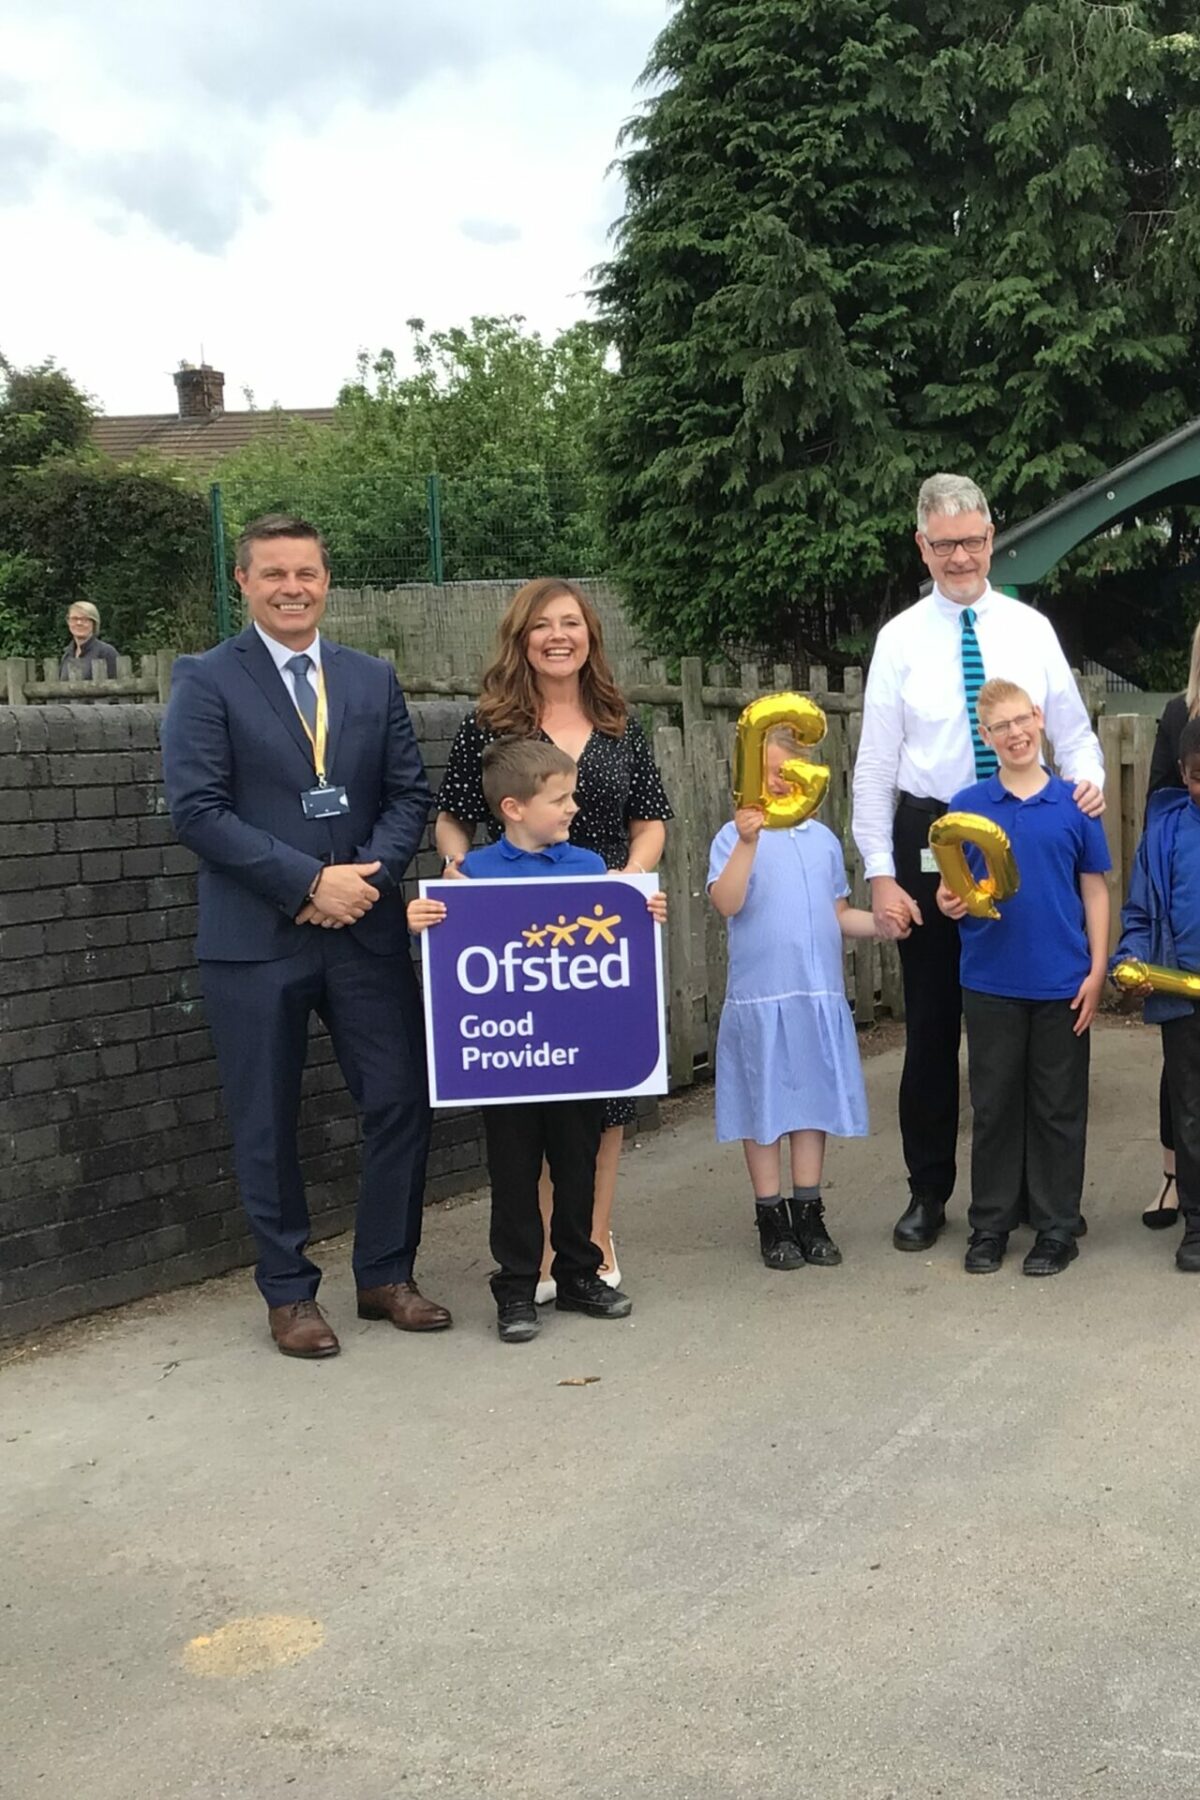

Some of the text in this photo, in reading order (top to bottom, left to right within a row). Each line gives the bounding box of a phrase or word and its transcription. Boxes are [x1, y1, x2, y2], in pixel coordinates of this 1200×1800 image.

[456, 937, 631, 995] Ofsted
[459, 1011, 534, 1039] Good
[462, 1041, 579, 1071] Provider
